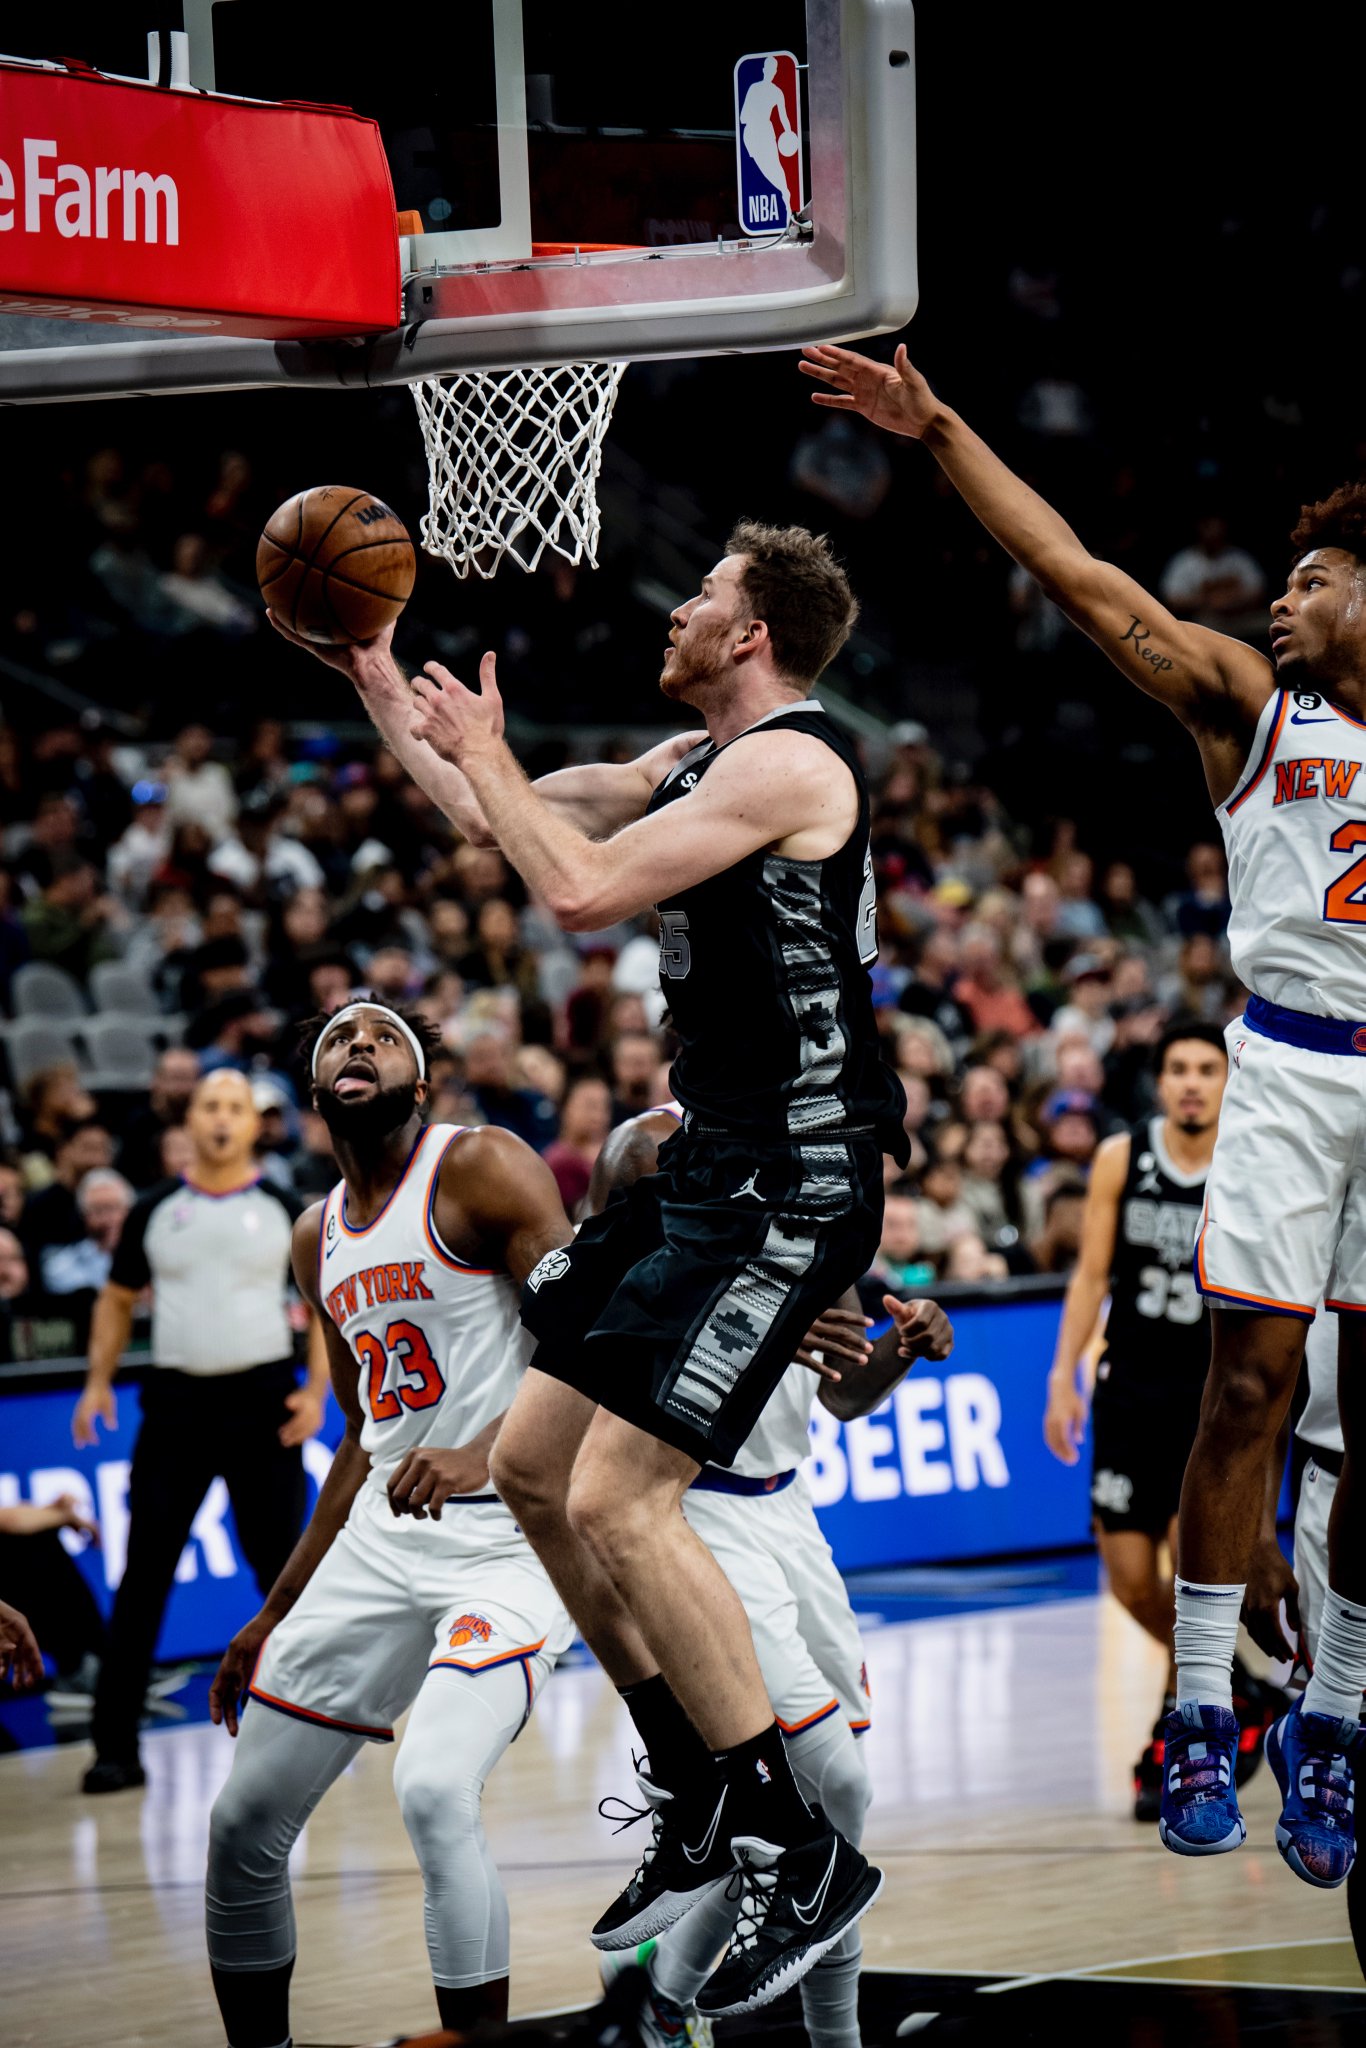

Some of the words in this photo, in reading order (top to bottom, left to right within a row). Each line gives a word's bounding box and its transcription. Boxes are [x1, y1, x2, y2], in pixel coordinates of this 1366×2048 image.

[748, 193, 780, 223] NBA
[1272, 757, 1362, 808] NEW
[358, 1261, 434, 1308] YORK
[1134, 1264, 1203, 1326] 33
[355, 1318, 447, 1423] 23
[799, 1371, 1011, 1508] BEER
